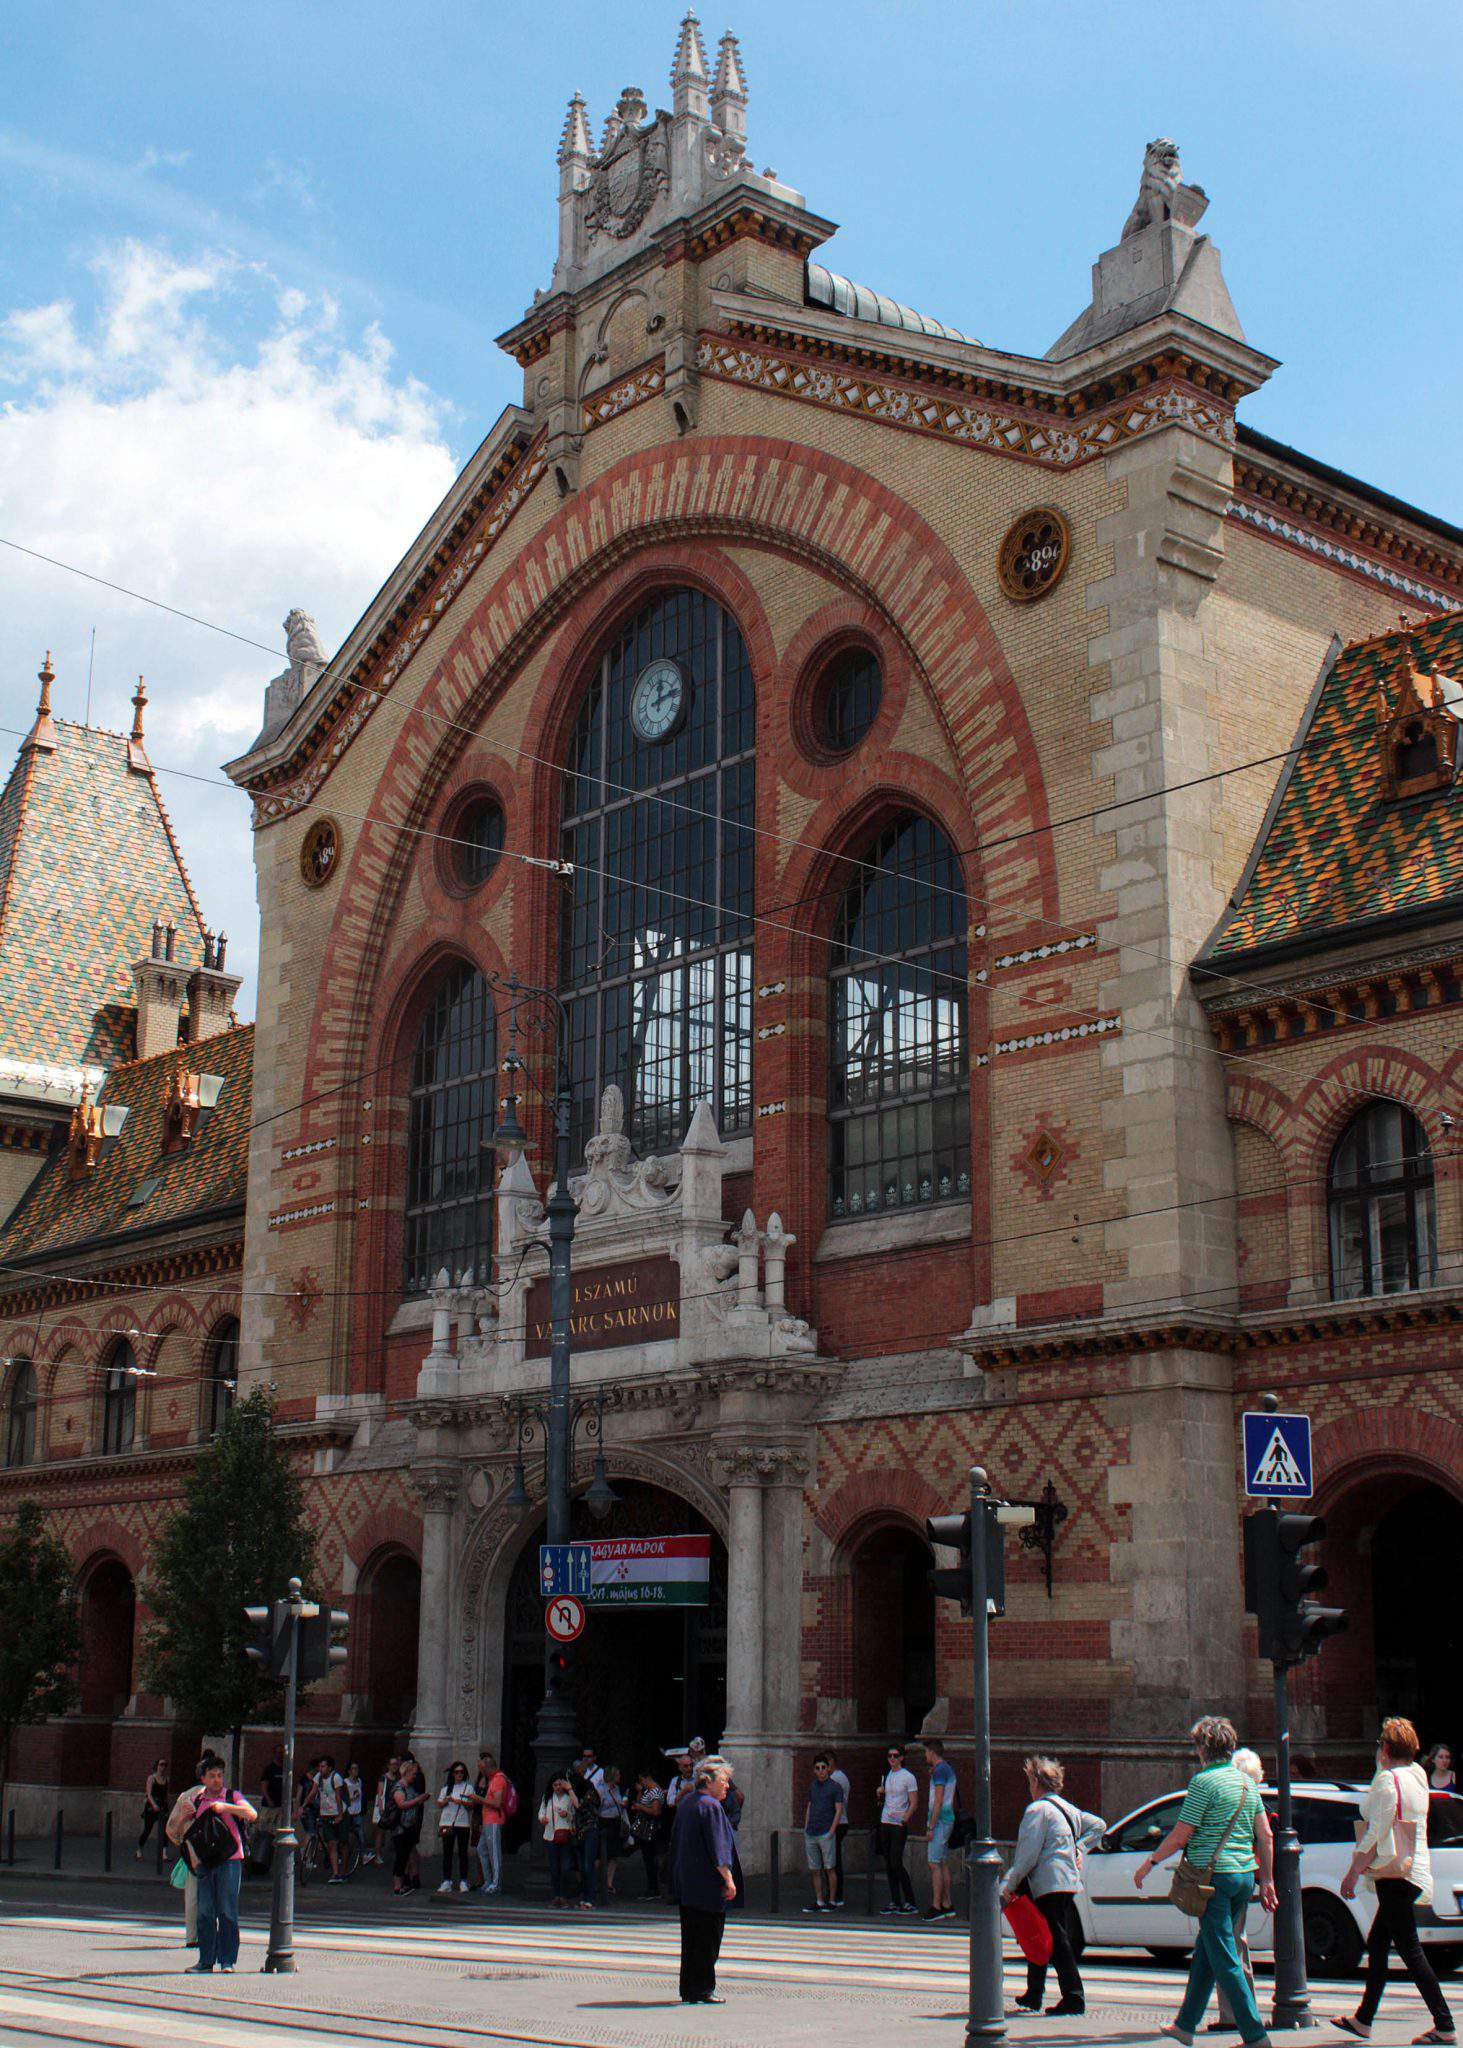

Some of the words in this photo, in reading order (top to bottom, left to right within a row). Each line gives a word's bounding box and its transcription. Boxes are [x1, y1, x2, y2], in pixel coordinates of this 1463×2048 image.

[536, 1301, 677, 1339] VÁRCSARNOK
[628, 1542, 665, 1554] NAPOK
[610, 1586, 638, 1600] május
